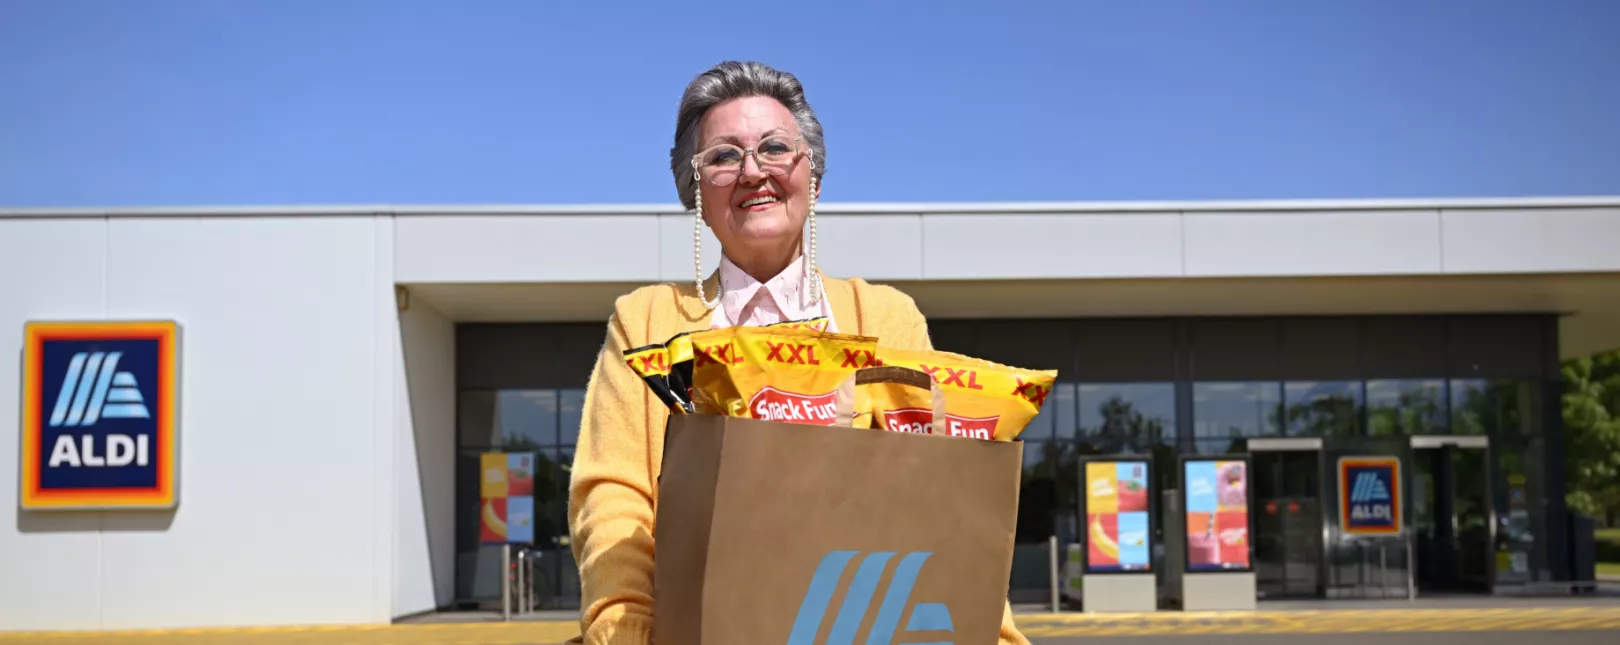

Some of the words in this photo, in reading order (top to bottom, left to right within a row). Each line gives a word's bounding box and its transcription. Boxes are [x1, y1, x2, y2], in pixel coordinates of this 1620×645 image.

[695, 343, 744, 367] XXL
[766, 341, 820, 365] XXL
[919, 364, 983, 389] XXL
[756, 399, 805, 420] Snack
[802, 400, 837, 420] Fun
[889, 419, 932, 433] Snac
[49, 434, 149, 467] ALDI
[1351, 504, 1392, 521] ALDI
